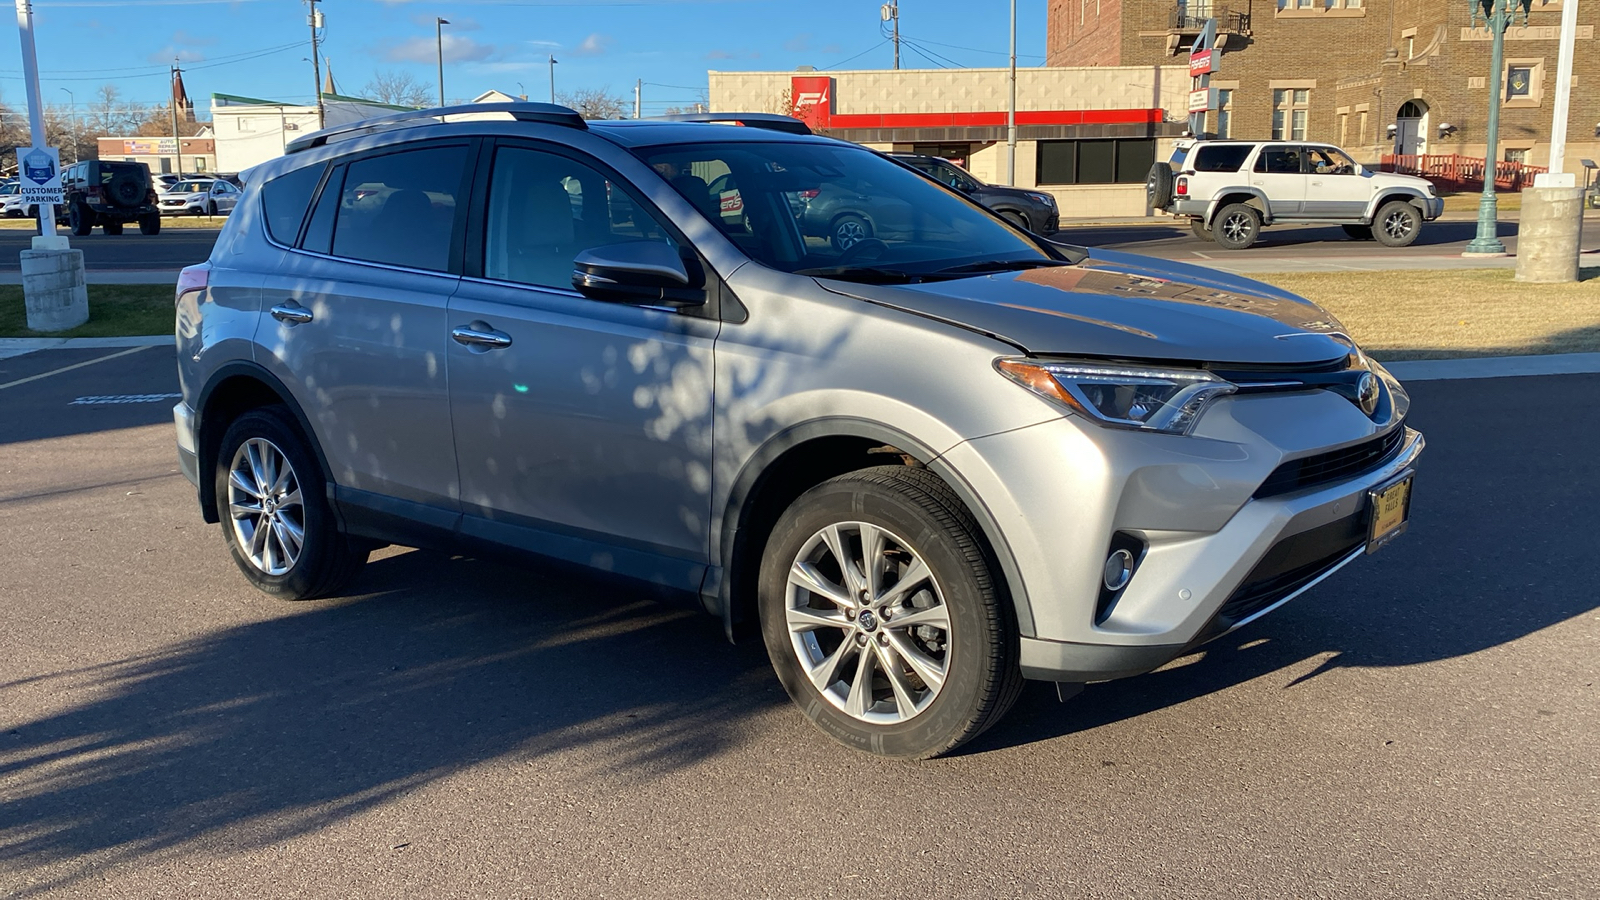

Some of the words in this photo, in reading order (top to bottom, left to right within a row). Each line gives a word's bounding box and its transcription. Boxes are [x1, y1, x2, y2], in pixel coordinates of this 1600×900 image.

[25, 195, 60, 203] PARKING
[1386, 487, 1401, 502] GREAT
[1384, 499, 1399, 514] FALLS
